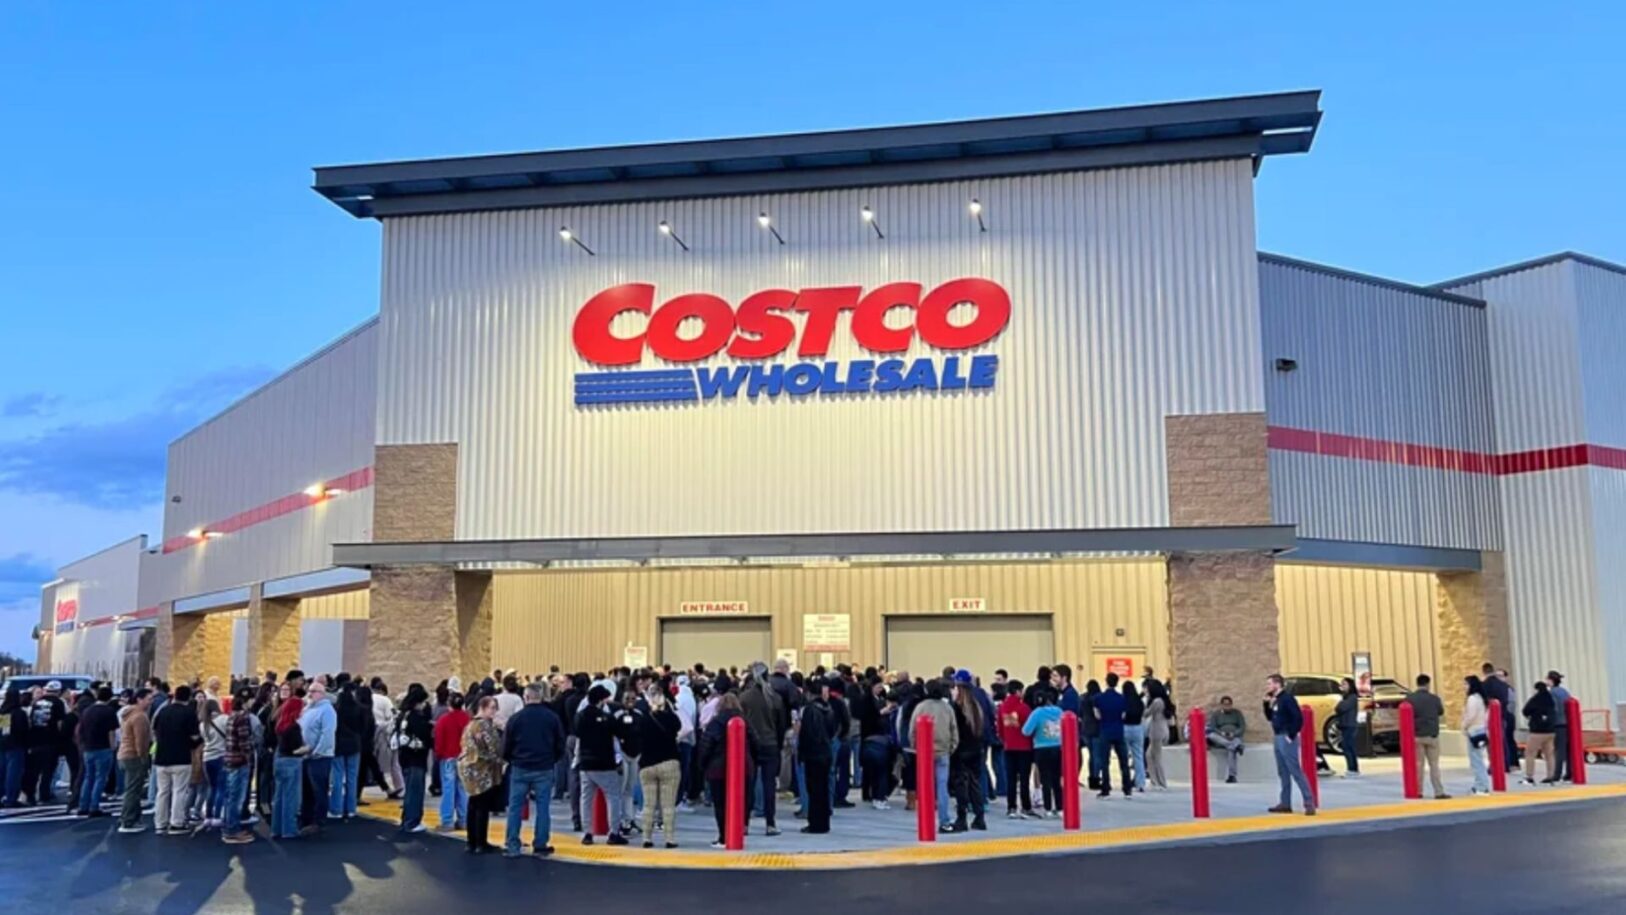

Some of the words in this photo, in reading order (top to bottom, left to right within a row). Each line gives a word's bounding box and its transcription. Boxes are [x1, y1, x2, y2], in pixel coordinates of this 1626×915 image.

[572, 277, 1011, 366] COSTCO
[697, 354, 999, 400] WHOLESALE
[682, 602, 746, 613] ENTRANCE
[952, 599, 981, 610] EXIT
